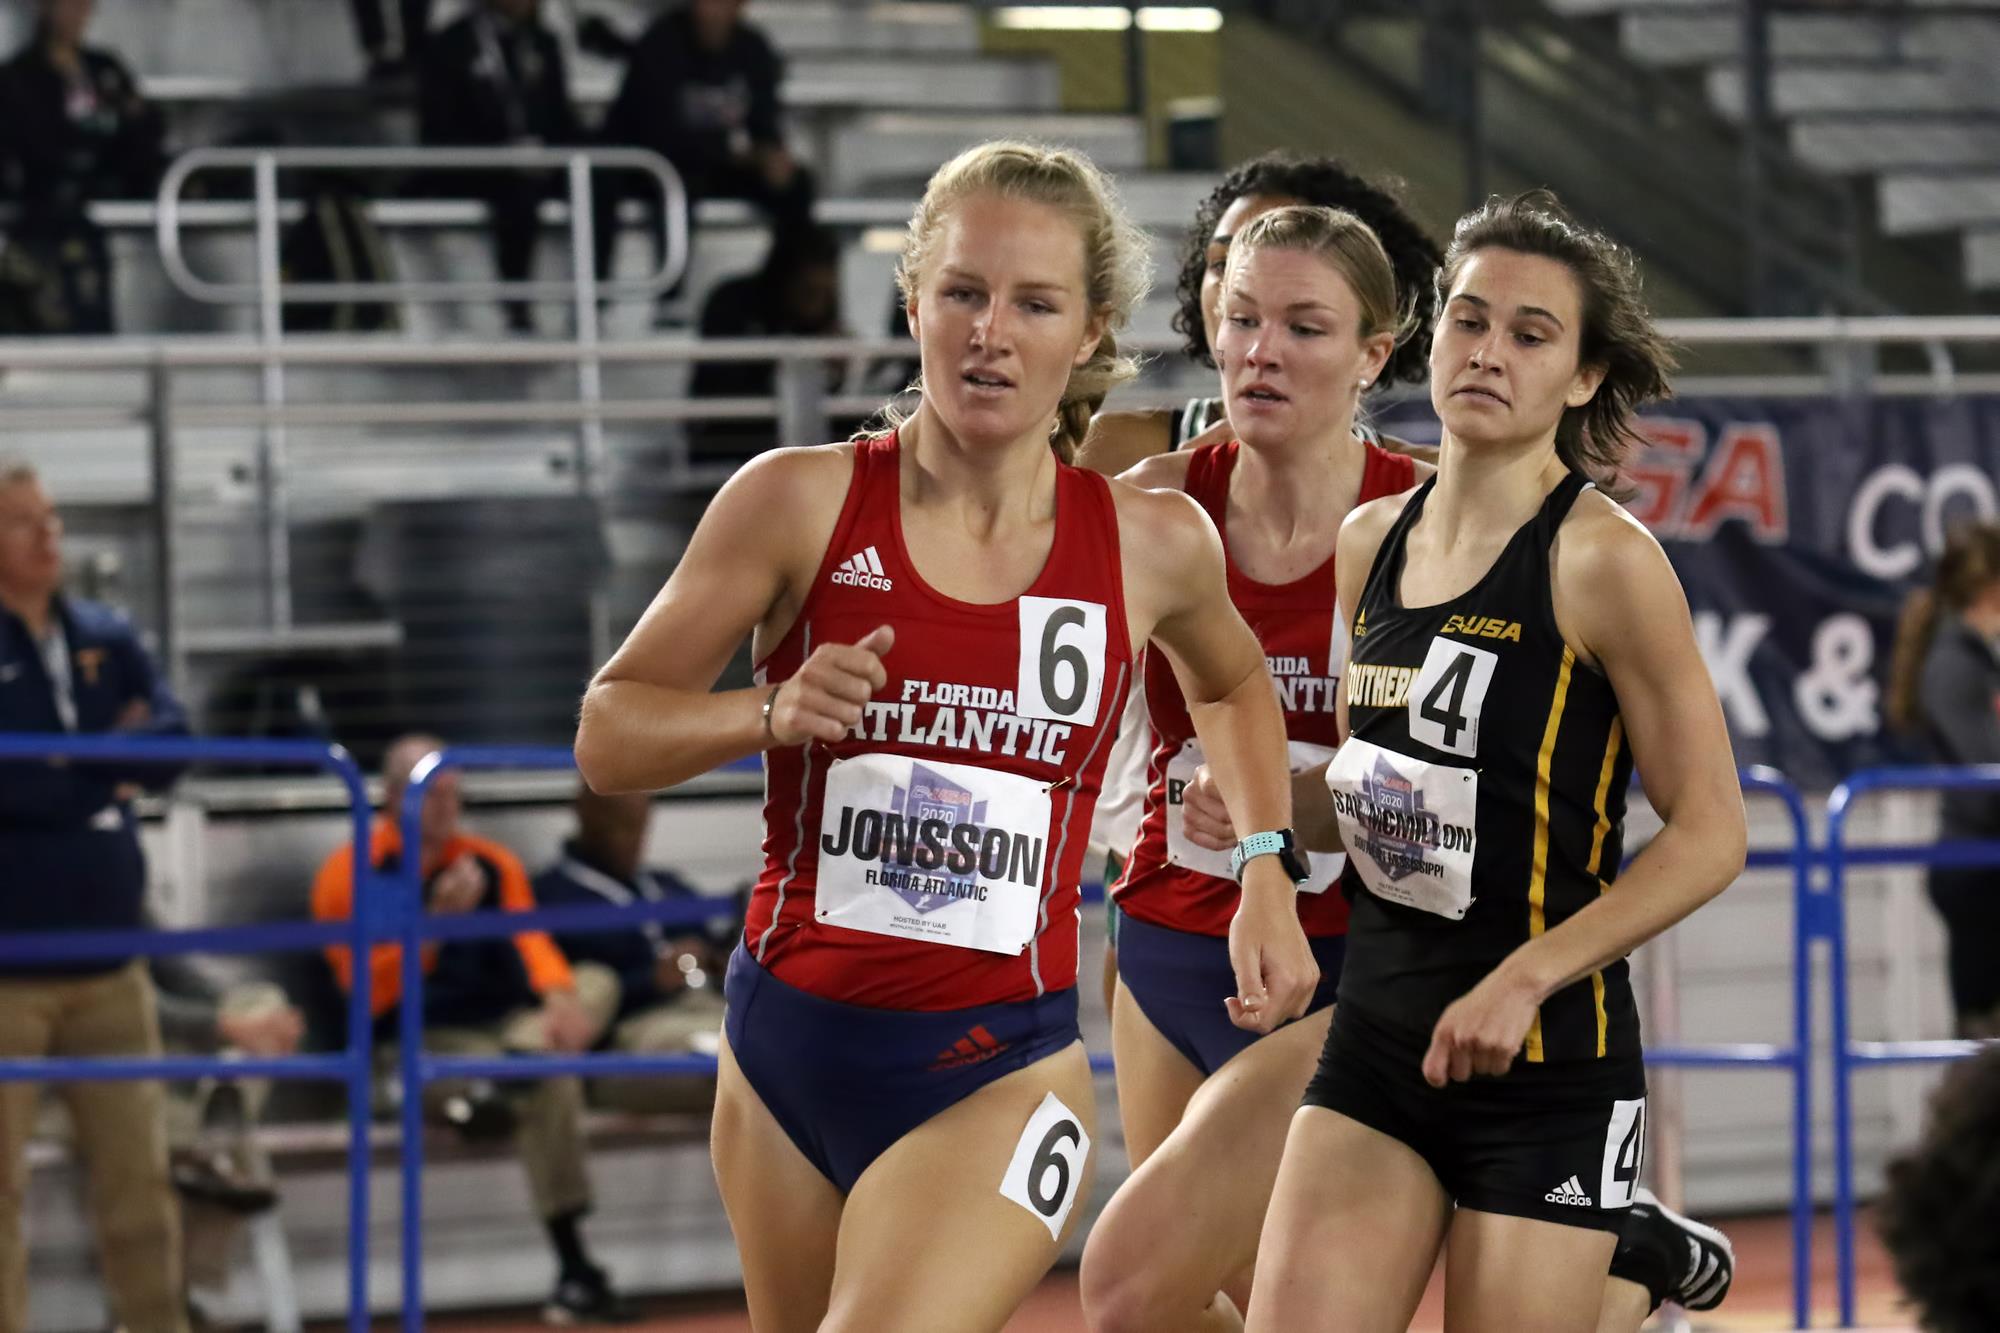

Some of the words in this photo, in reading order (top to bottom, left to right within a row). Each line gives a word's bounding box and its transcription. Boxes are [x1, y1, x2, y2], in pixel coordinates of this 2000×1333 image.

[832, 570, 892, 592] adidas
[1039, 606, 1089, 716] 6
[1348, 661, 1425, 708] OUTHER
[1794, 612, 1880, 742] &
[902, 679, 1015, 712] FLORIDA
[1421, 651, 1476, 748] 4
[922, 807, 954, 824] 2020
[1380, 793, 1402, 808] 2020
[821, 806, 1043, 887] JONSSON
[865, 869, 919, 891] FLORIDA
[924, 878, 988, 902] ATLANTIC
[1027, 1119, 1081, 1217] 6
[1613, 1106, 1643, 1200] 4
[1544, 1192, 1592, 1207] adidas
